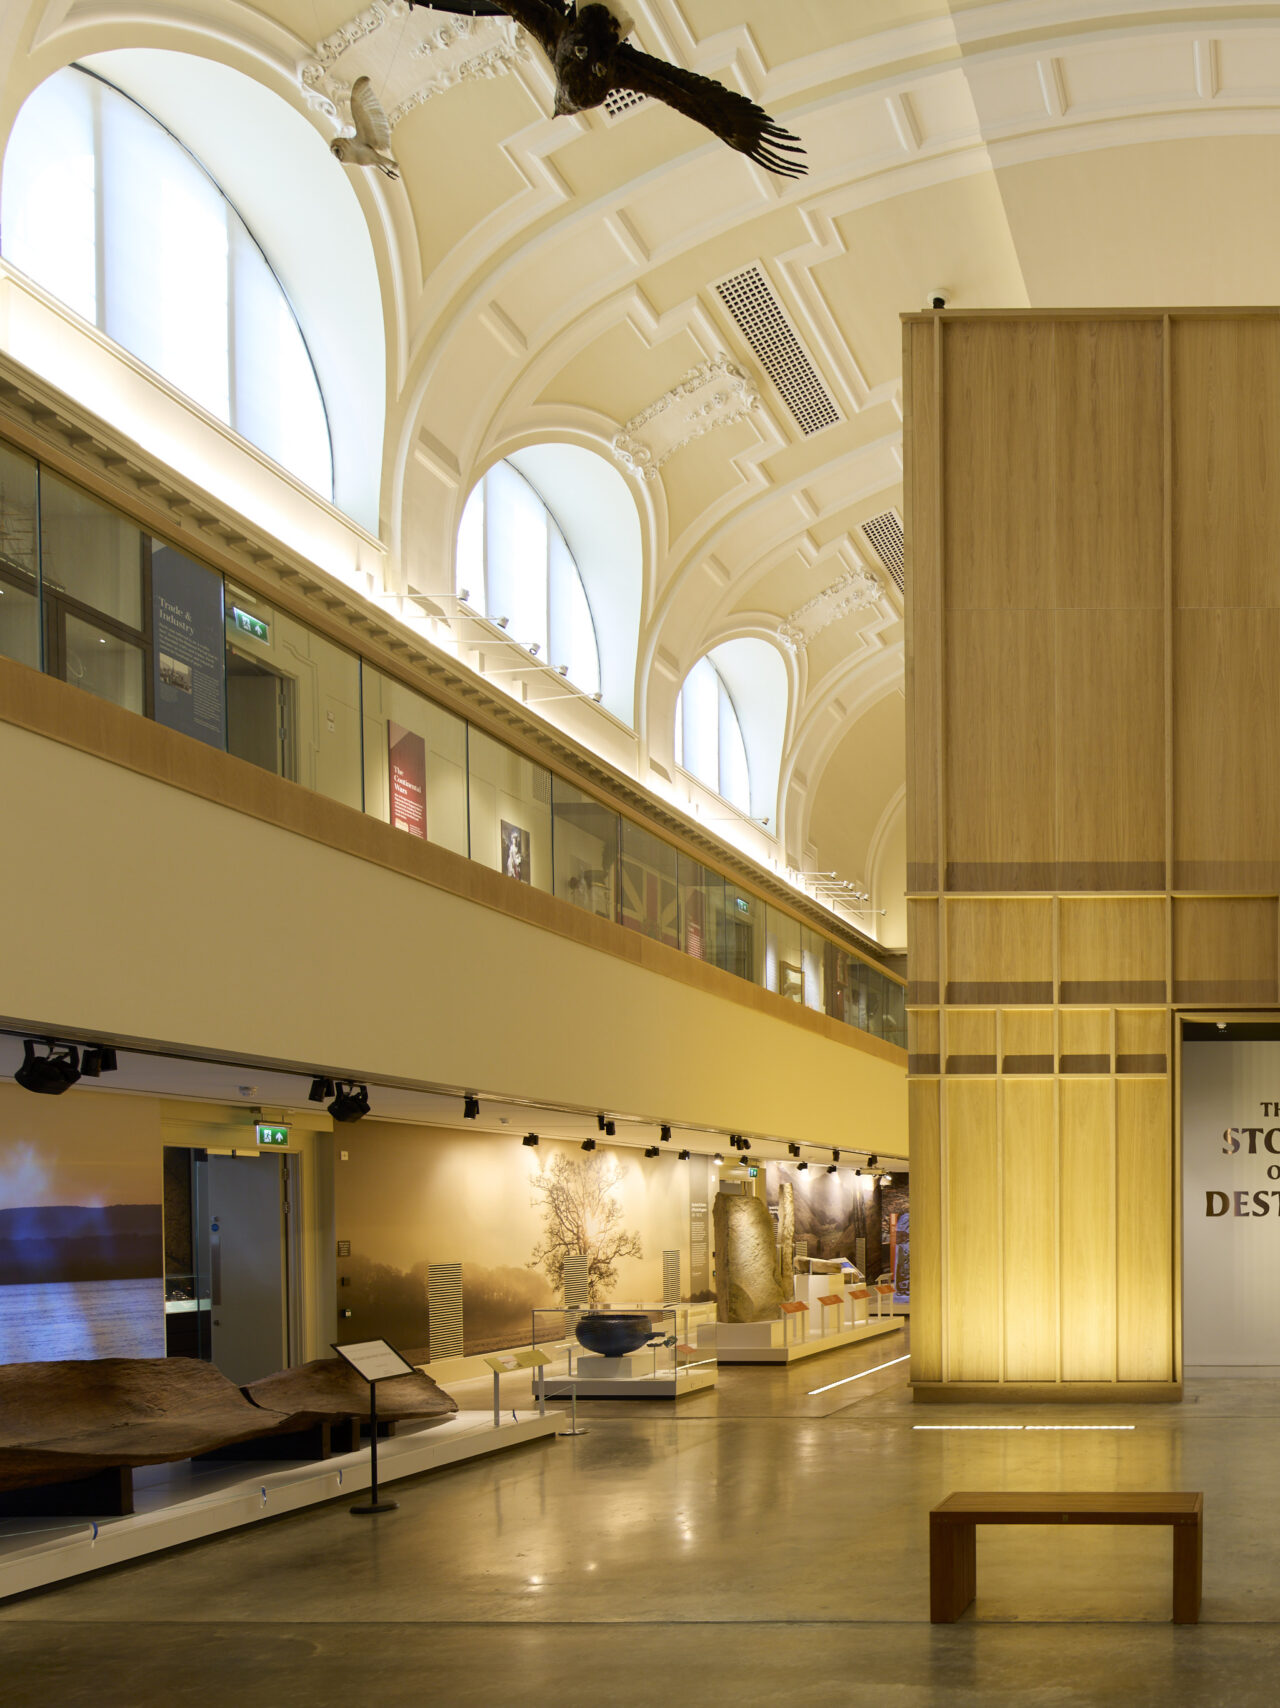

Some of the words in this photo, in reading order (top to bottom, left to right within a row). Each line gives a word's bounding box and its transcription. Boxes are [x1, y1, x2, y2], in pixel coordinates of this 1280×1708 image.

[159, 596, 183, 617] Trade
[185, 611, 192, 622] &
[160, 608, 194, 636] Industry
[393, 765, 404, 776] The
[394, 774, 422, 793] Continental
[394, 782, 408, 795] Wars
